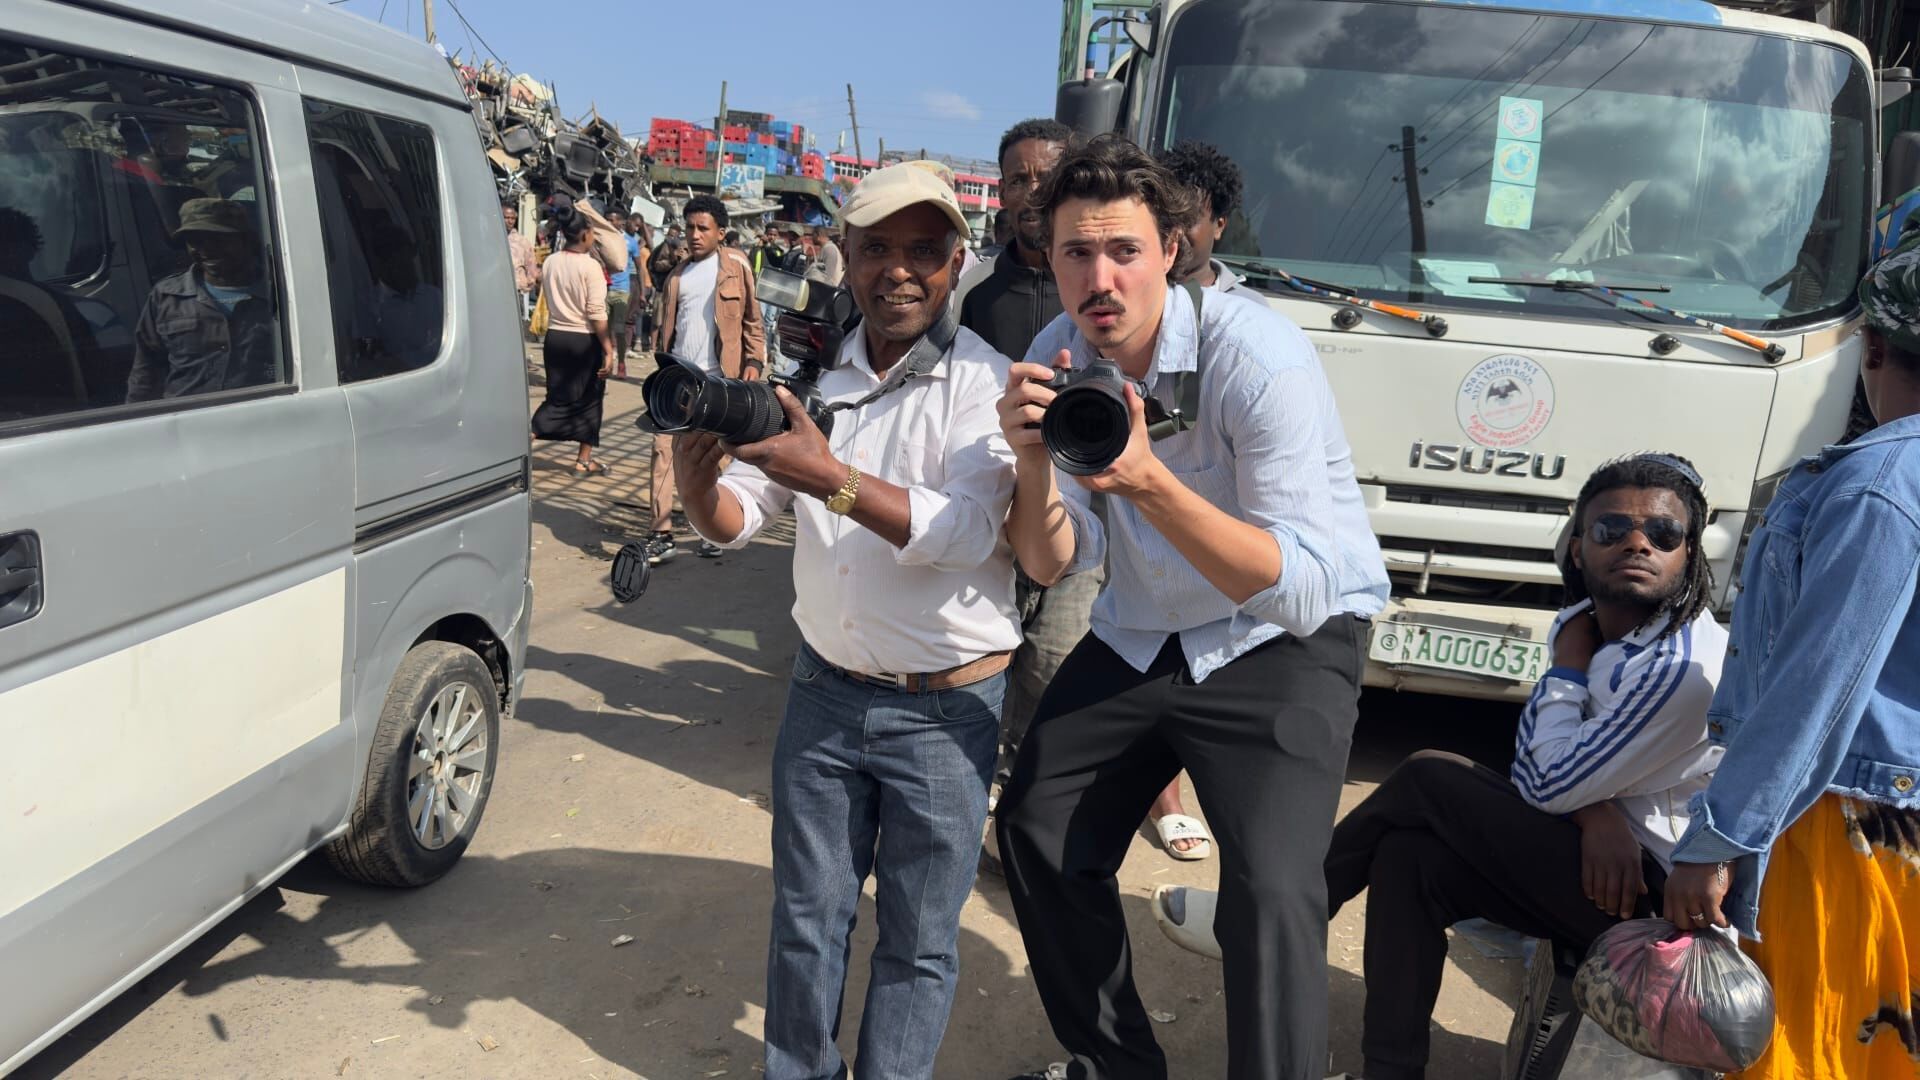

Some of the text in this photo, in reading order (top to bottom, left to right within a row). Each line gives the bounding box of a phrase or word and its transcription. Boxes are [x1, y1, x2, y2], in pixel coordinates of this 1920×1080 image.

[1488, 423, 1528, 439] Industrial
[1528, 399, 1545, 424] Group
[1409, 440, 1568, 480] ISUZU
[1416, 632, 1529, 675] A00063
